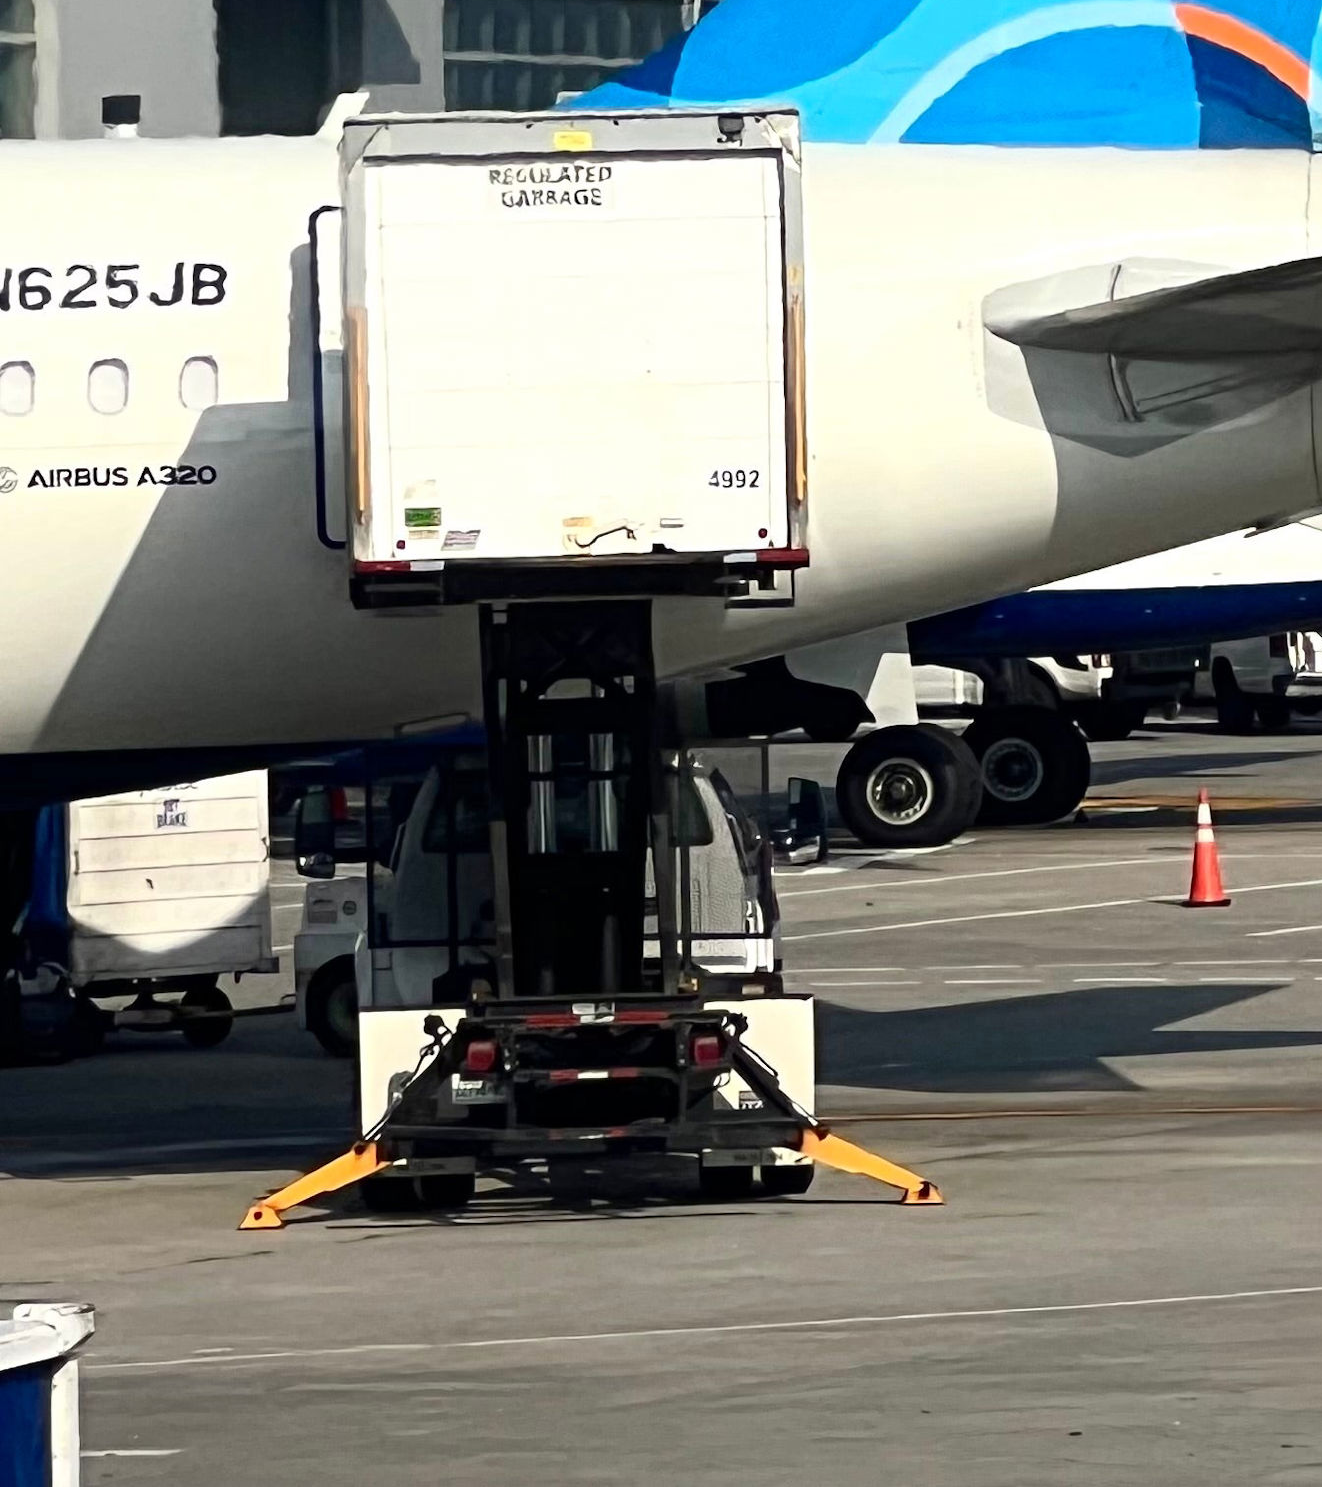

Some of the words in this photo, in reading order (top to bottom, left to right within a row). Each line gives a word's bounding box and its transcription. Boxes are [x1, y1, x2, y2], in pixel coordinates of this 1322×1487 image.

[488, 164, 612, 186] REGULATED
[501, 187, 603, 208] GARBAGE
[27, 466, 129, 489] AIRBUS
[137, 465, 217, 487] A320
[708, 469, 760, 489] 4992
